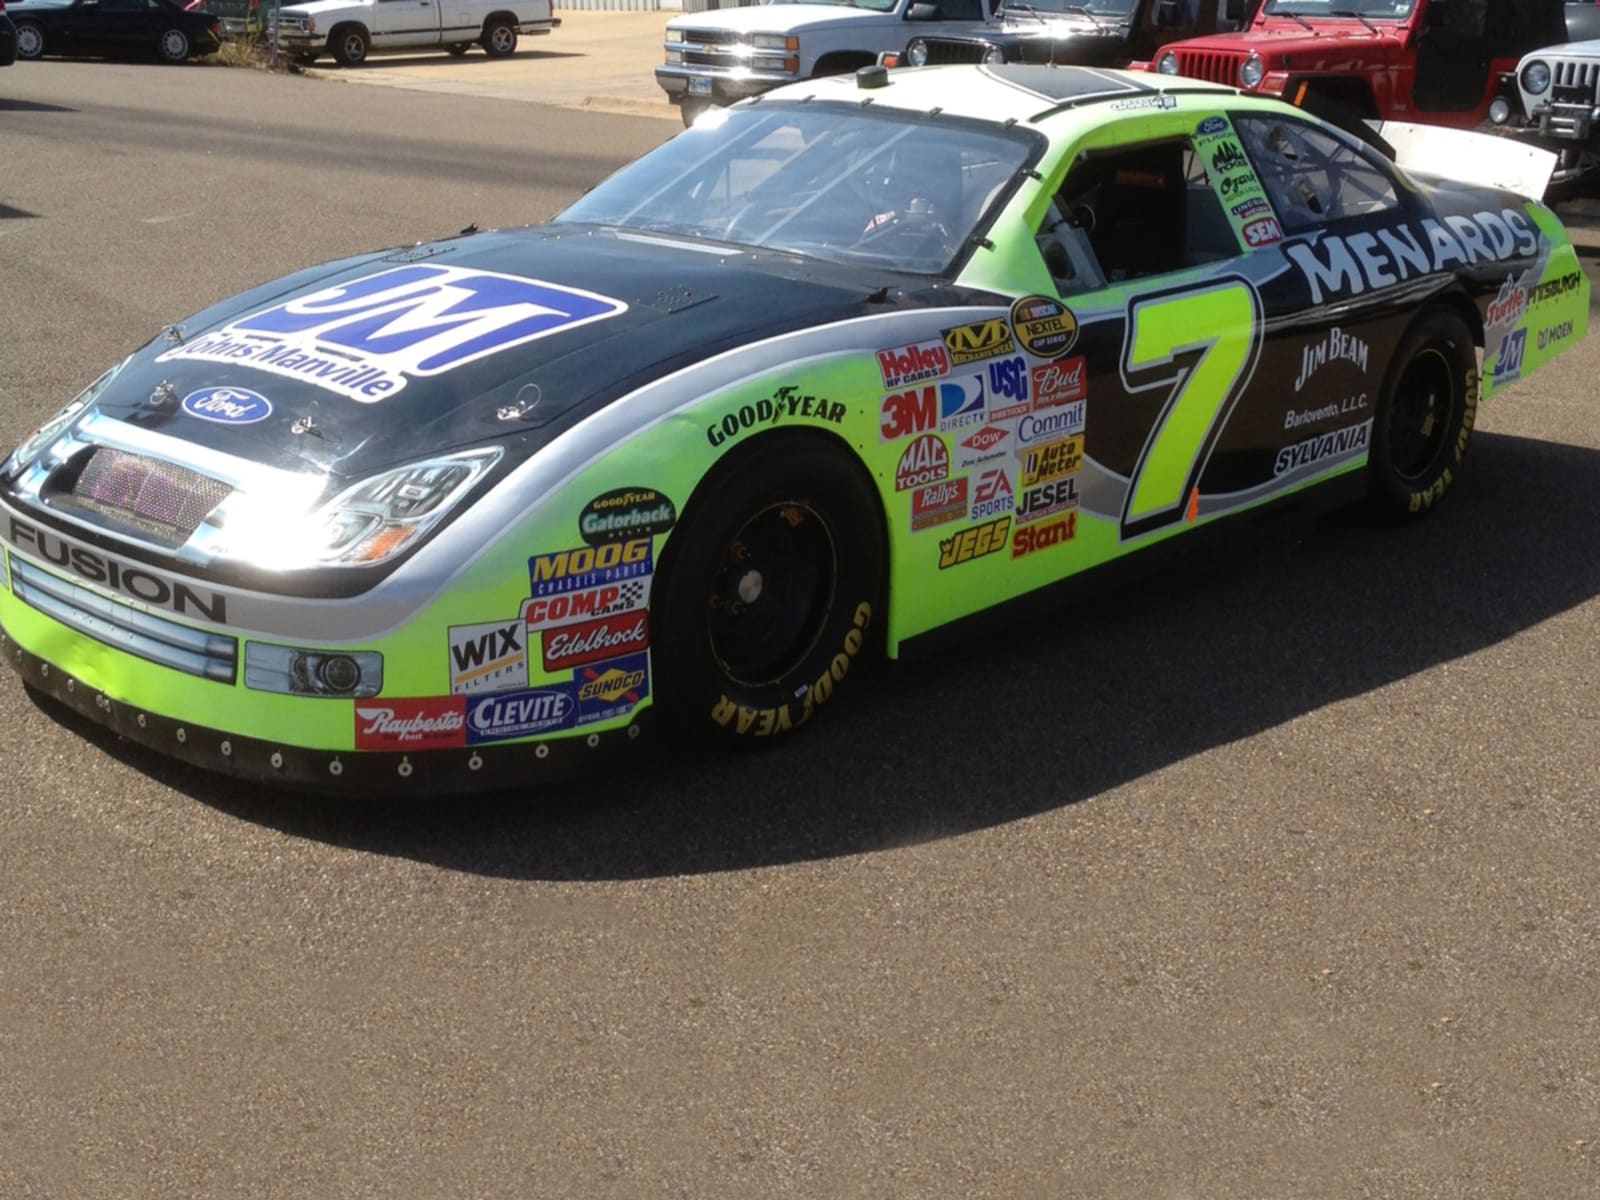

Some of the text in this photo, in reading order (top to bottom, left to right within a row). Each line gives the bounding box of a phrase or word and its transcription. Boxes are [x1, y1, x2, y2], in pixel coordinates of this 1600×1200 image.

[1246, 220, 1281, 244] SEM
[1287, 208, 1537, 304] MENARDS
[1025, 318, 1067, 336] NEXTEL
[1548, 320, 1574, 344] MOEN
[168, 333, 397, 397] Johns Manville
[879, 345, 949, 378] Holley
[903, 367, 938, 384] CARBS
[1295, 326, 1369, 392] JIM BEAM
[989, 356, 1029, 402] USG
[1034, 362, 1082, 395] Bud
[193, 388, 257, 419] Ford
[881, 385, 938, 440] 3M
[1120, 275, 1263, 540] 7
[941, 412, 985, 432] DIRECTV
[1018, 404, 1084, 443] Commit
[899, 439, 947, 476] MAC
[1041, 441, 1076, 465] Auto
[1275, 423, 1369, 474] SYLVANIA
[898, 466, 947, 488] TOOLS
[921, 480, 959, 508] Rally's
[974, 469, 1012, 504] EA
[971, 495, 1015, 520] SPORTS
[1016, 477, 1080, 516] JESEL
[581, 503, 672, 533] Gatorback
[1011, 511, 1077, 559] Stant
[532, 538, 651, 583] MOOG
[939, 516, 1011, 570] JEGS
[9, 516, 227, 624] FUSION
[537, 561, 647, 595] CHASSIS PARTS
[525, 585, 620, 625] COMP
[591, 600, 635, 617] CAMS
[451, 622, 522, 672] WIX
[545, 617, 646, 661] Edelbrock
[454, 661, 525, 693] FILTERS
[579, 668, 645, 699] SUNOCO
[473, 693, 565, 730] CLEVITE
